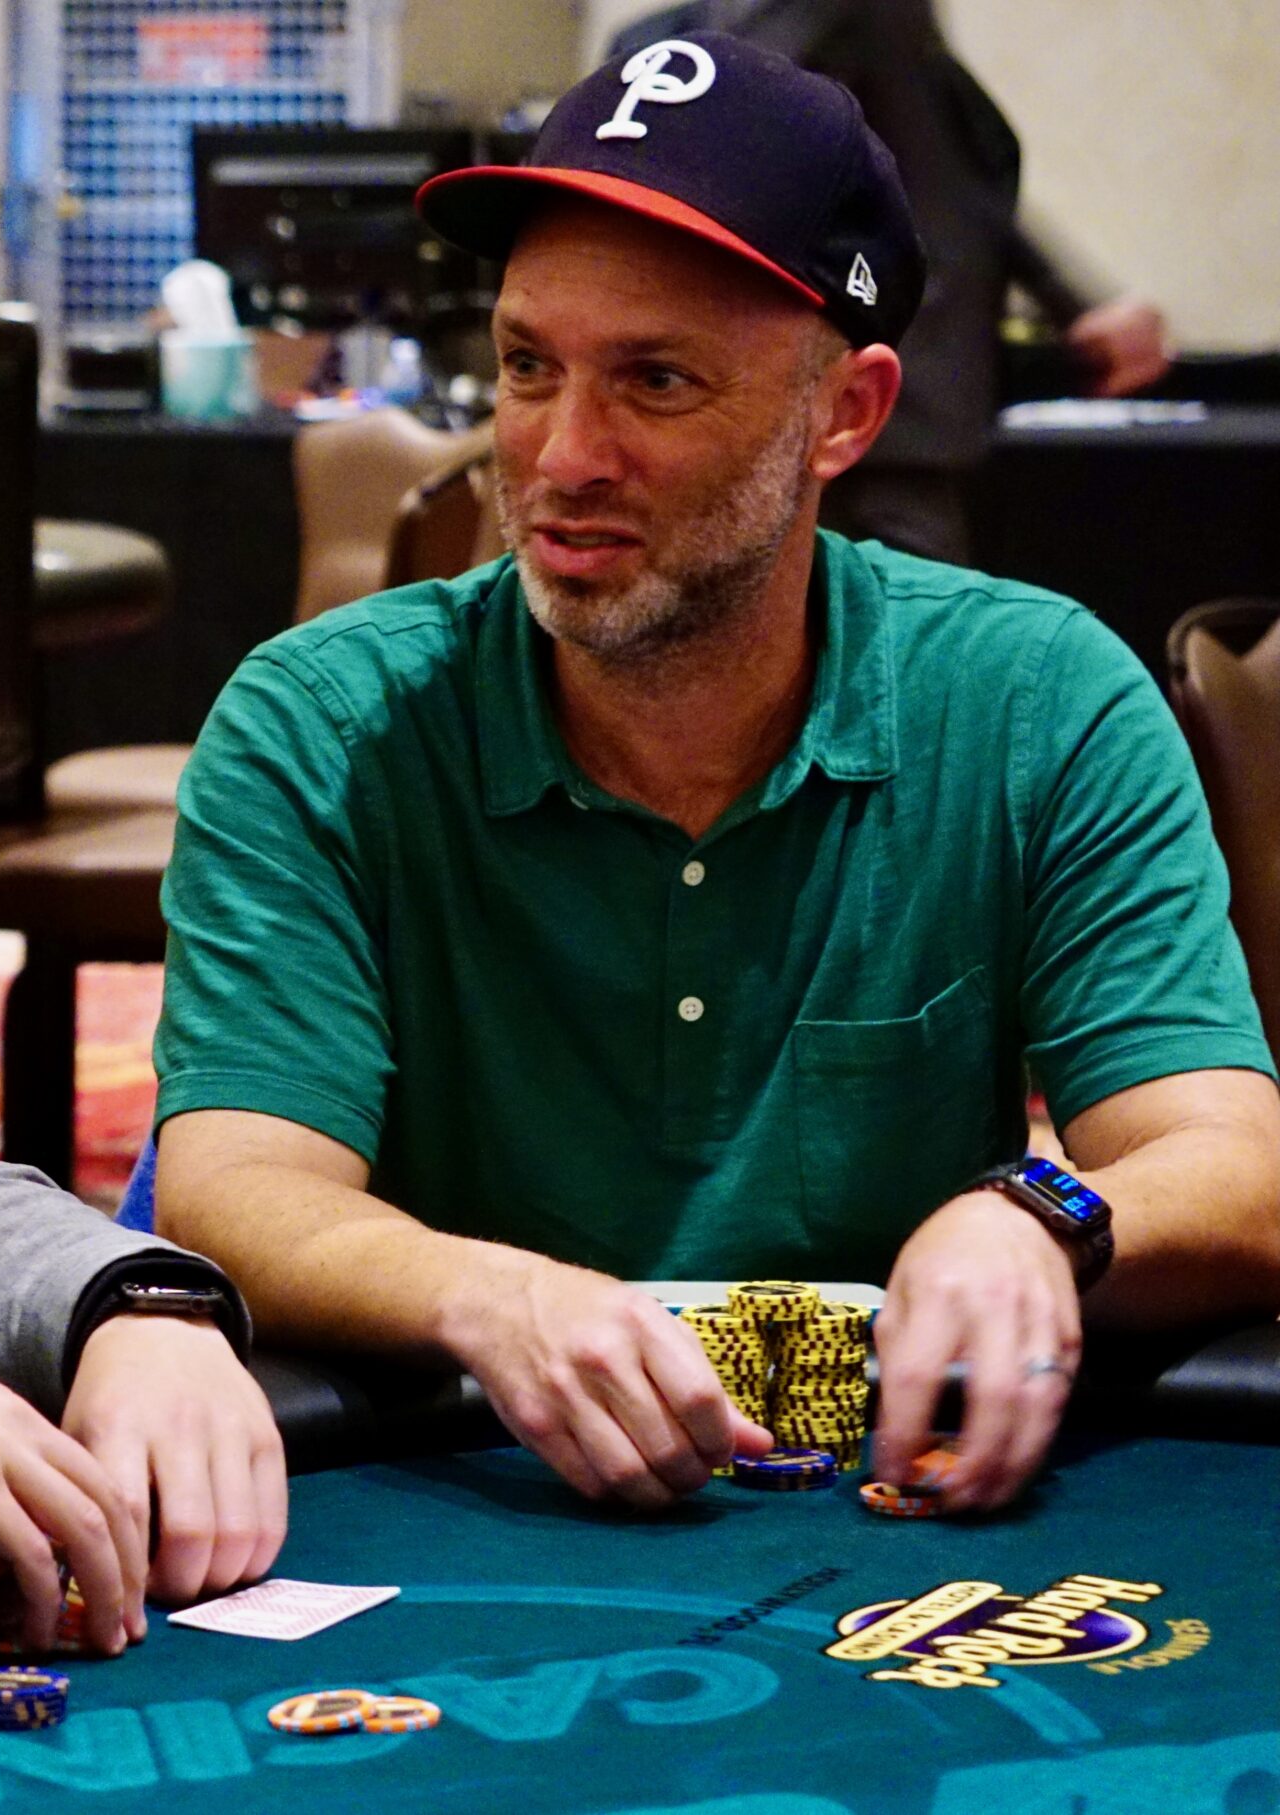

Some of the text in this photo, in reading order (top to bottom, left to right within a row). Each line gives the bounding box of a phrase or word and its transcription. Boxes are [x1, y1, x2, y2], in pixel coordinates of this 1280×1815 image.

[596, 39, 716, 140] P
[919, 1584, 984, 1615] HOTEL
[842, 1620, 919, 1656] CASINO
[868, 1574, 1163, 1689] Hard Rock
[1086, 1619, 1211, 1675] SEMINOLE
